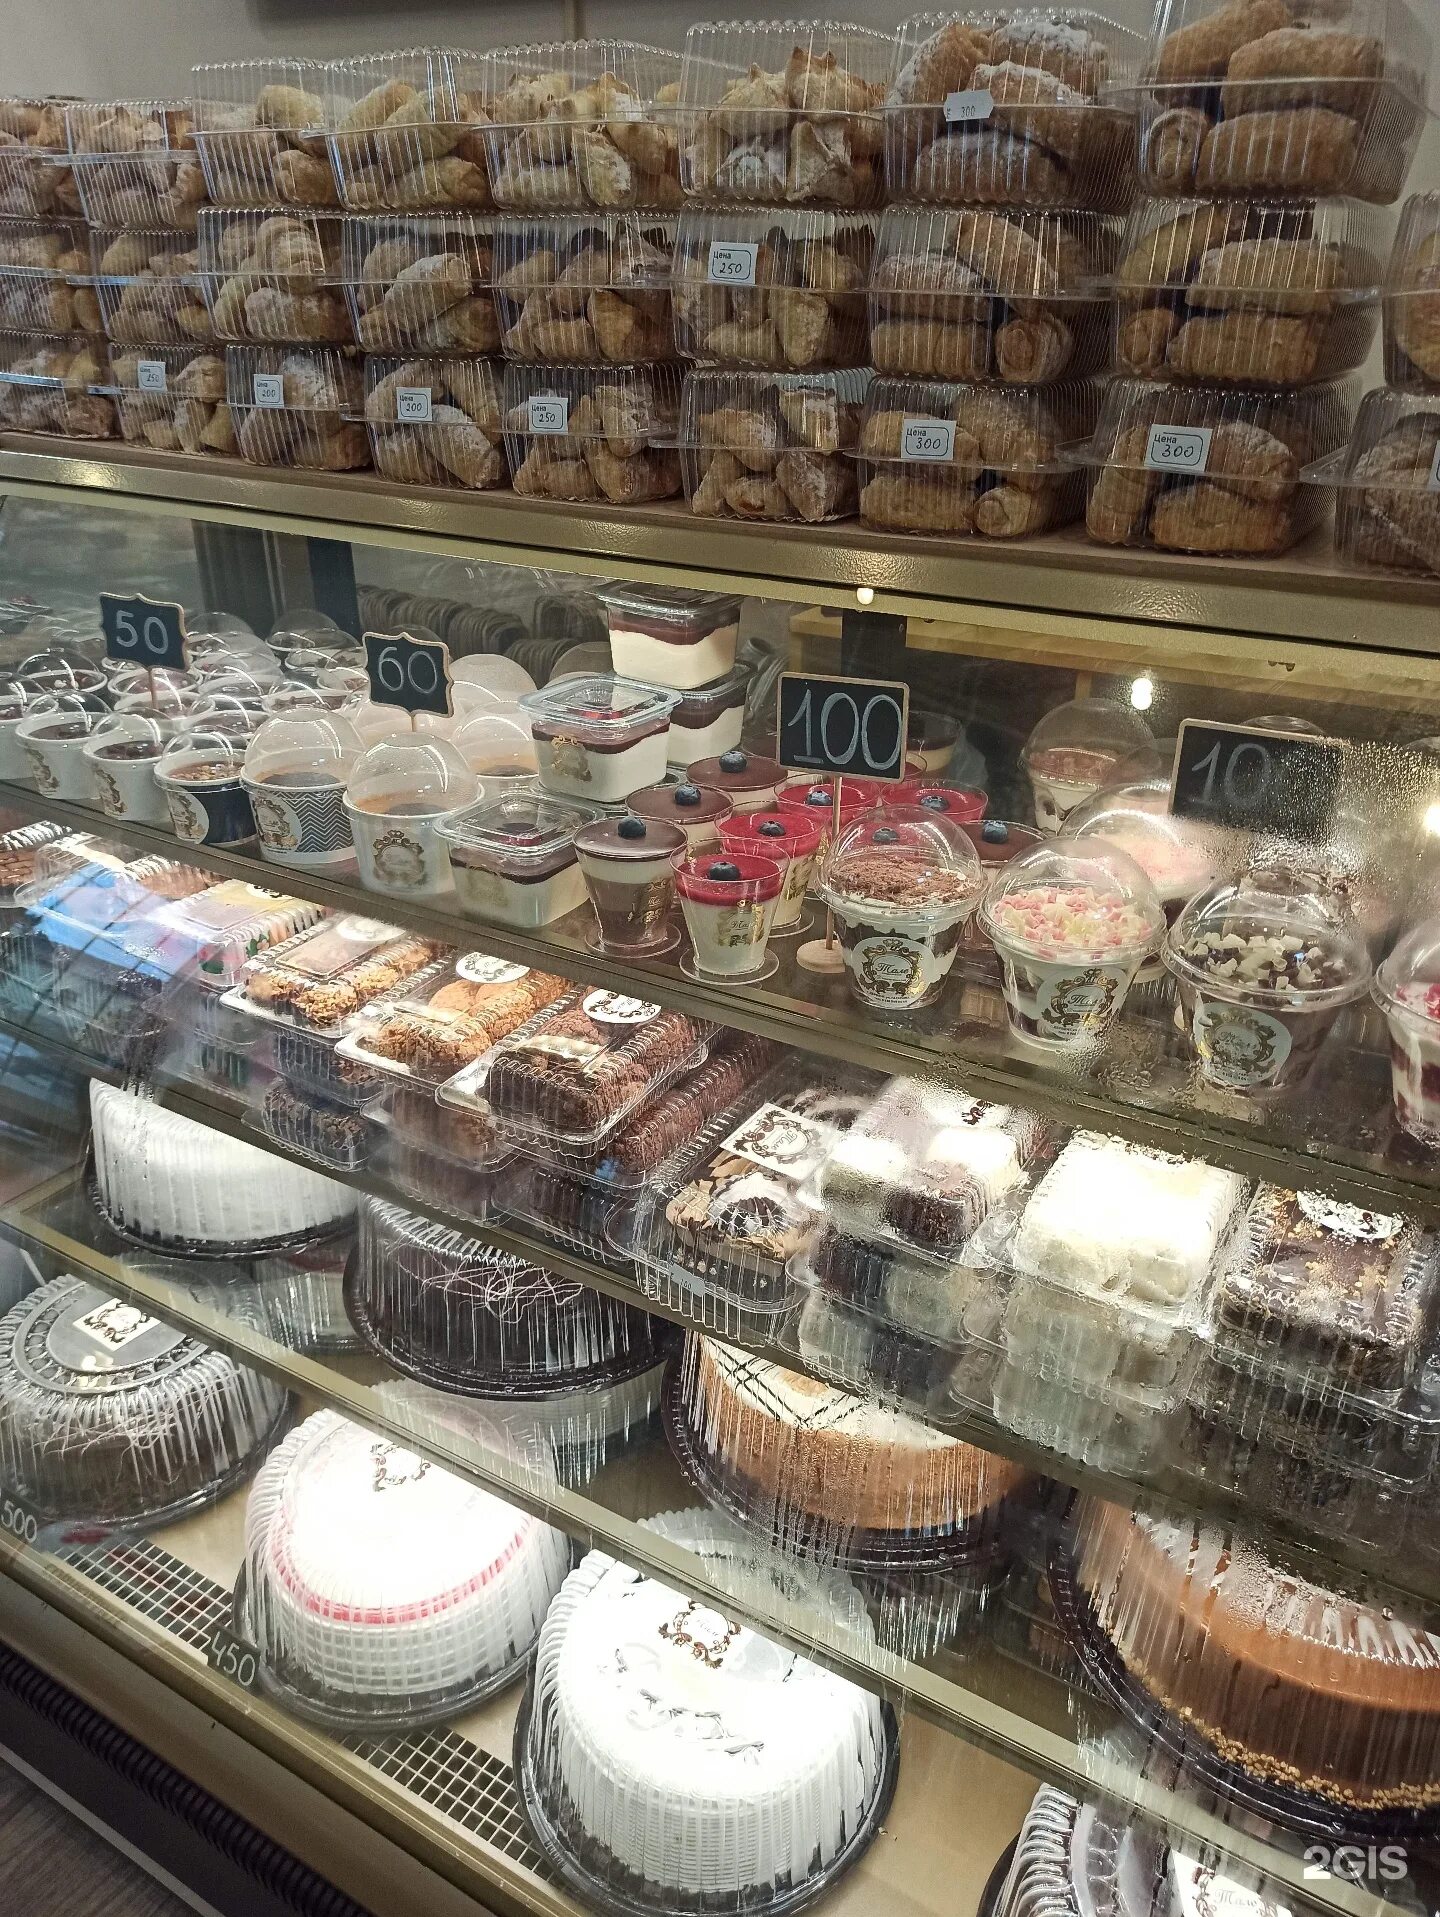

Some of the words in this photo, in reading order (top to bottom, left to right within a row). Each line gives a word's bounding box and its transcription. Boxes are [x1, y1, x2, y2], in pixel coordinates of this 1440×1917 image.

[961, 105, 976, 119] 300
[713, 251, 732, 260] Цена
[720, 262, 742, 275] 250
[406, 402, 422, 412] 200
[539, 412, 556, 423] 250
[907, 428, 927, 437] Цена
[1154, 434, 1177, 444] Цена
[916, 437, 941, 450] 300
[1162, 444, 1194, 458] 300
[116, 610, 169, 654] 50
[378, 646, 437, 694] 60
[788, 689, 901, 770] 100
[1, 1500, 37, 1543] 500
[212, 1631, 256, 1686] 450
